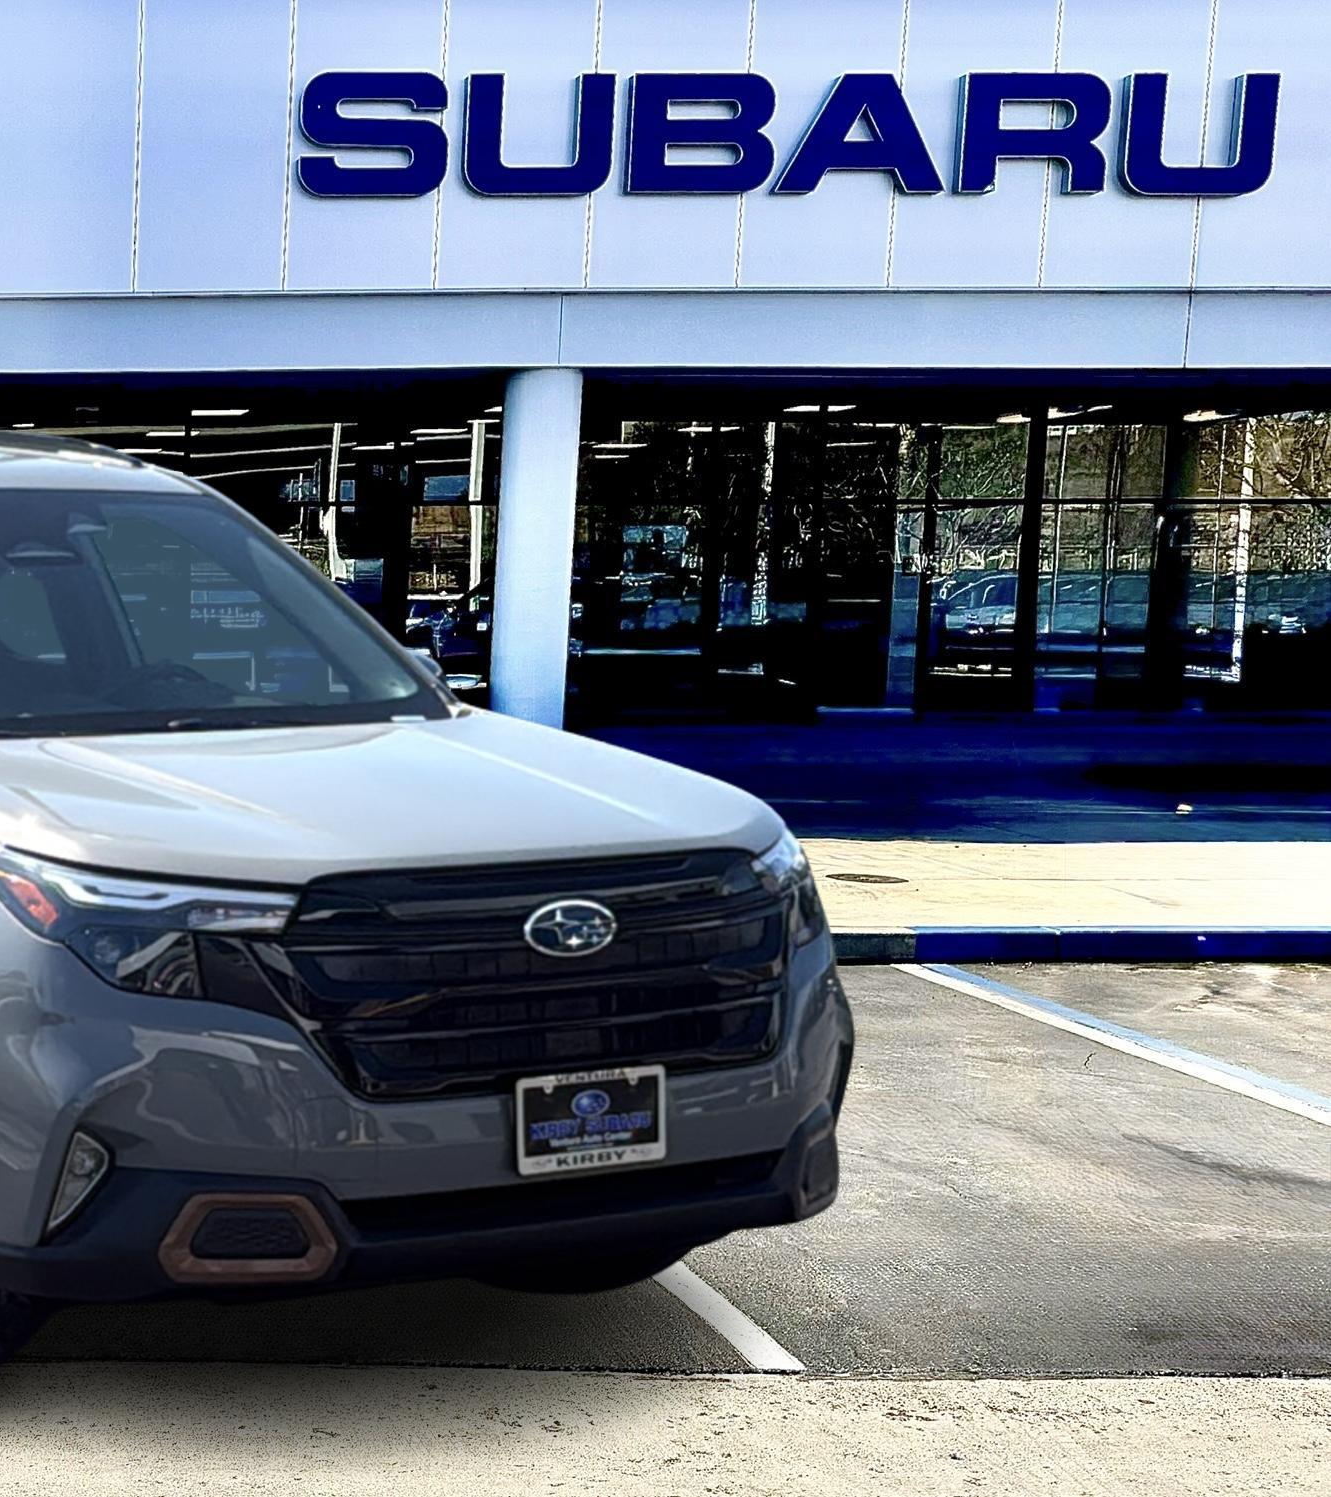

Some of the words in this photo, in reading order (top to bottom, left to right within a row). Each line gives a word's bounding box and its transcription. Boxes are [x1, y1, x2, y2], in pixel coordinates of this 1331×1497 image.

[296, 70, 1281, 198] SUBARU
[555, 1069, 626, 1083] VENTURA
[529, 1118, 581, 1141] KIRBY
[585, 1111, 652, 1133] SUBARU
[556, 1150, 627, 1167] KIRBY
